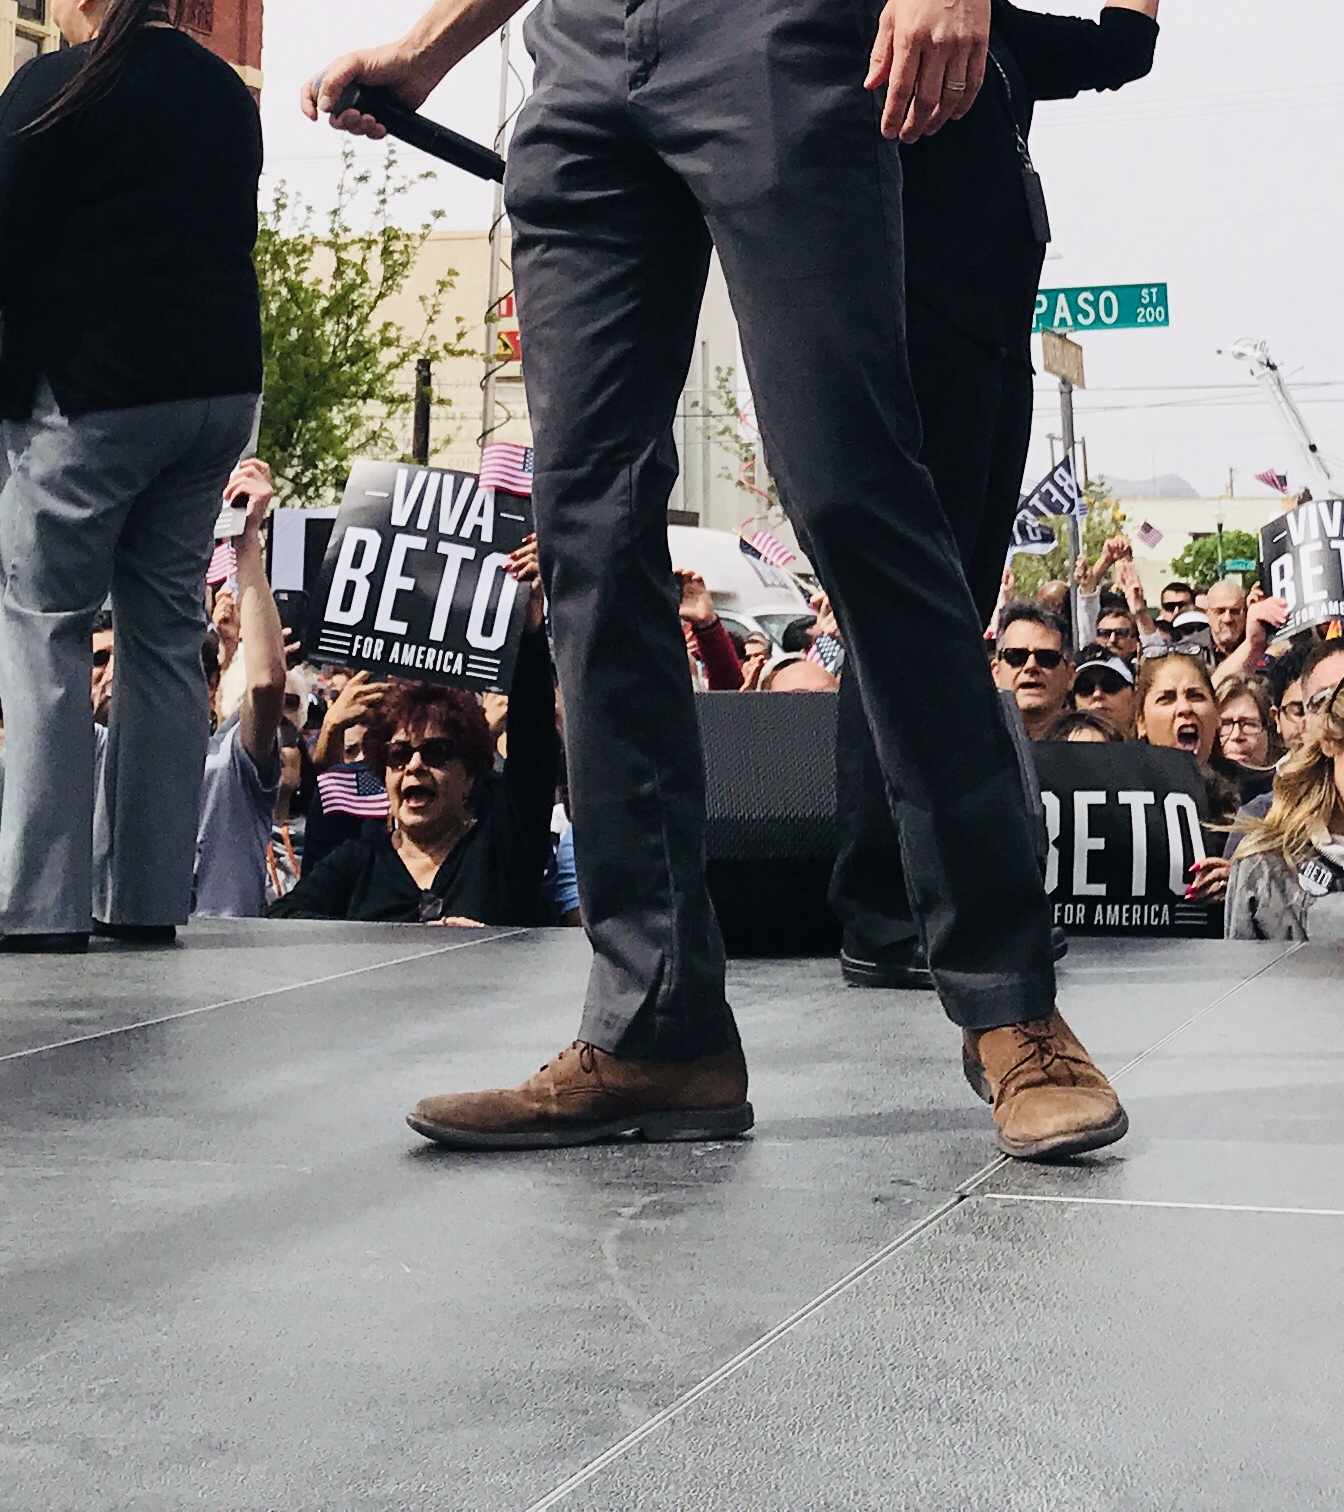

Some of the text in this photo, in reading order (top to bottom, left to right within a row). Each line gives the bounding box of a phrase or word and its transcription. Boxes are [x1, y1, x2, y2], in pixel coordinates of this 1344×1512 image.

[1032, 290, 1119, 329] PASO
[1140, 287, 1158, 305] ST
[1136, 305, 1165, 324] 200
[390, 468, 496, 543] VIVA
[323, 526, 519, 652] BETO
[1294, 606, 1317, 627] FOR
[351, 634, 464, 676] FOR AMERICA
[1053, 903, 1171, 926] FOR AMERICA
